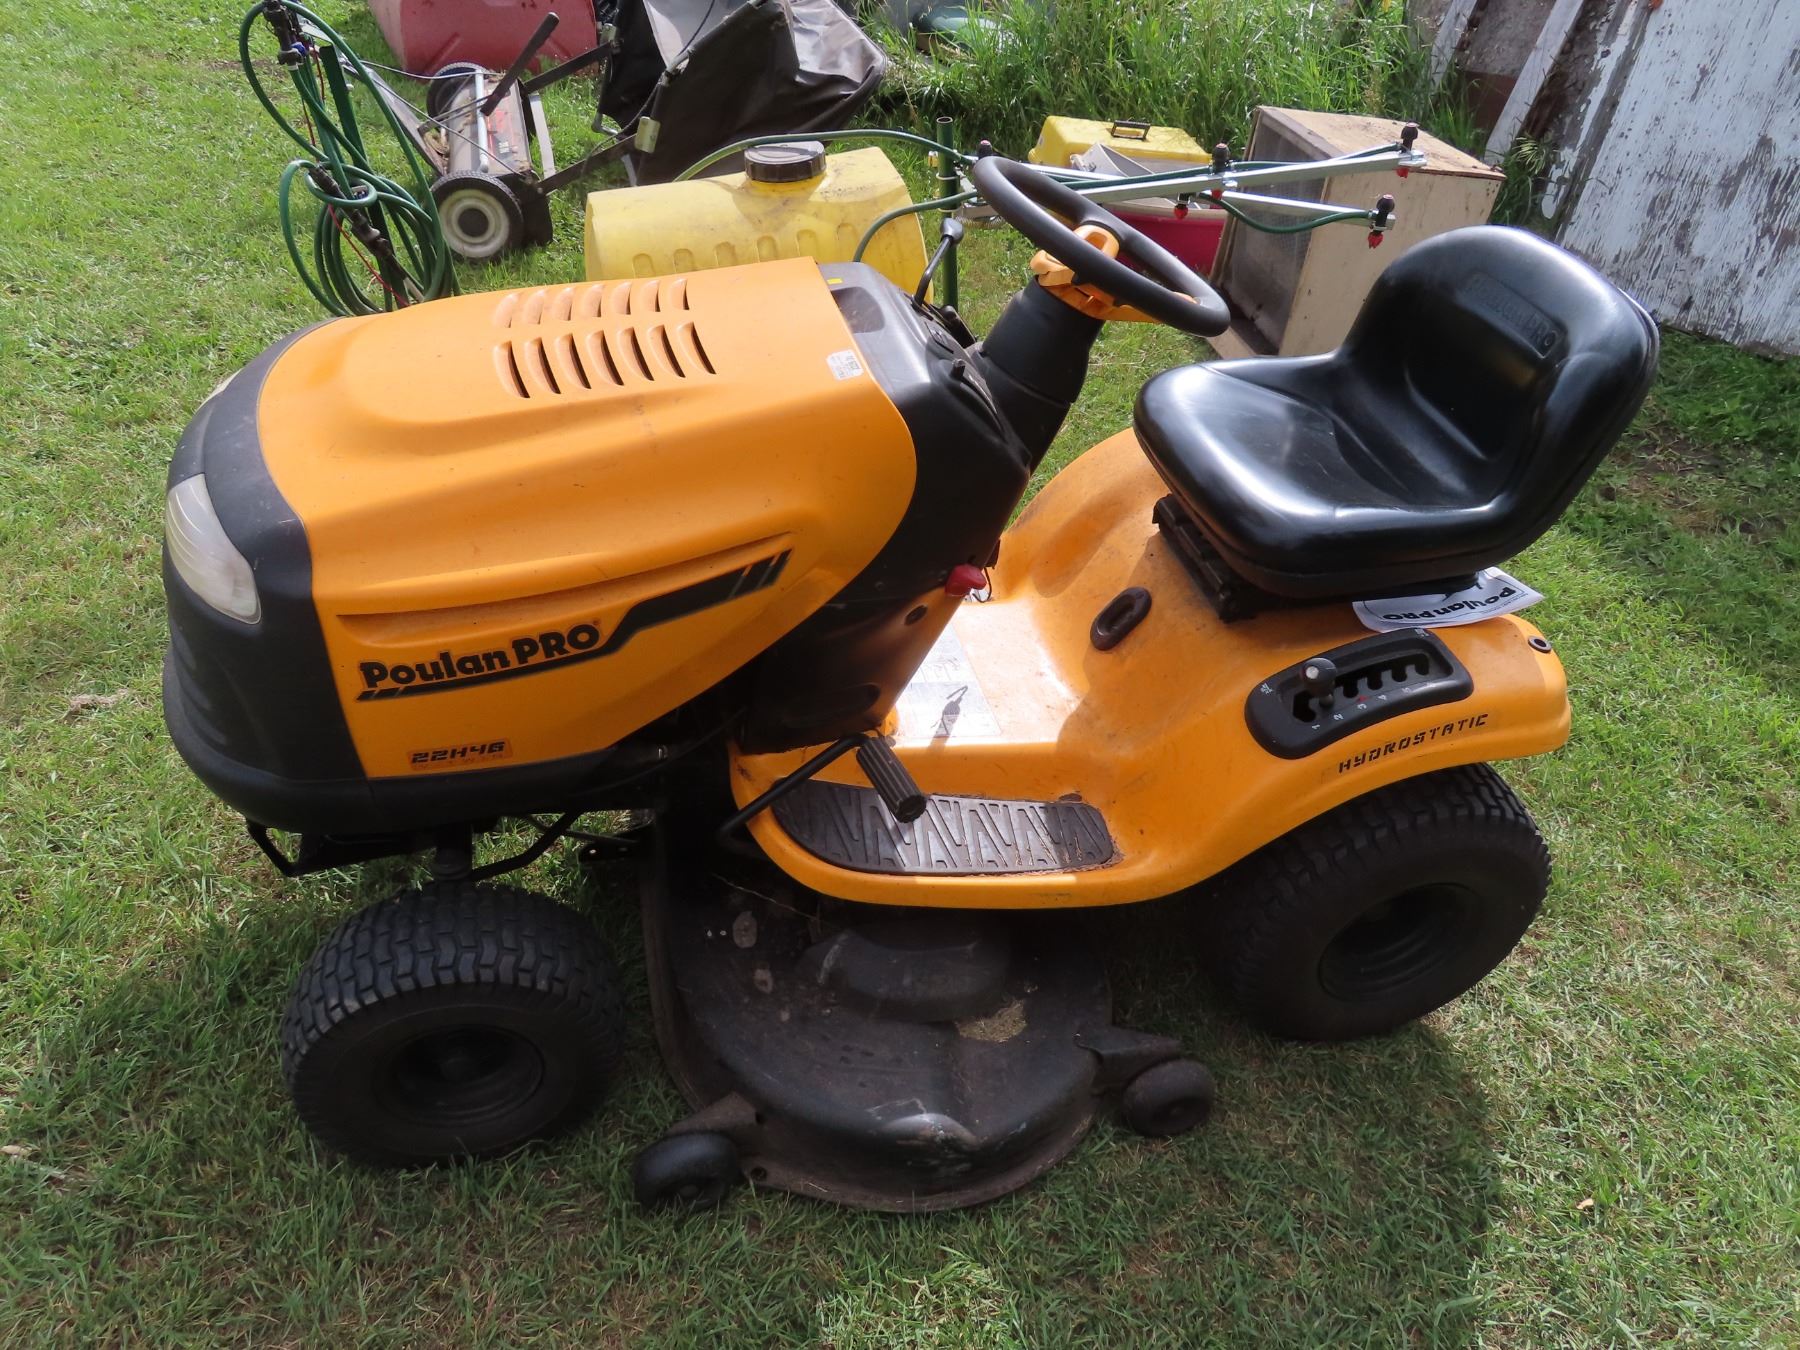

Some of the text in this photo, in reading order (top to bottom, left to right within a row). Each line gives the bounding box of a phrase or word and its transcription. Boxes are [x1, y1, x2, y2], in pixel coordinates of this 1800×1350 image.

[1382, 609, 1431, 621] PRO
[1433, 586, 1517, 615] Poulan
[359, 623, 600, 689] Poulan PRO
[410, 741, 506, 765] 22H46
[1338, 713, 1489, 774] HYDROSTATIC
